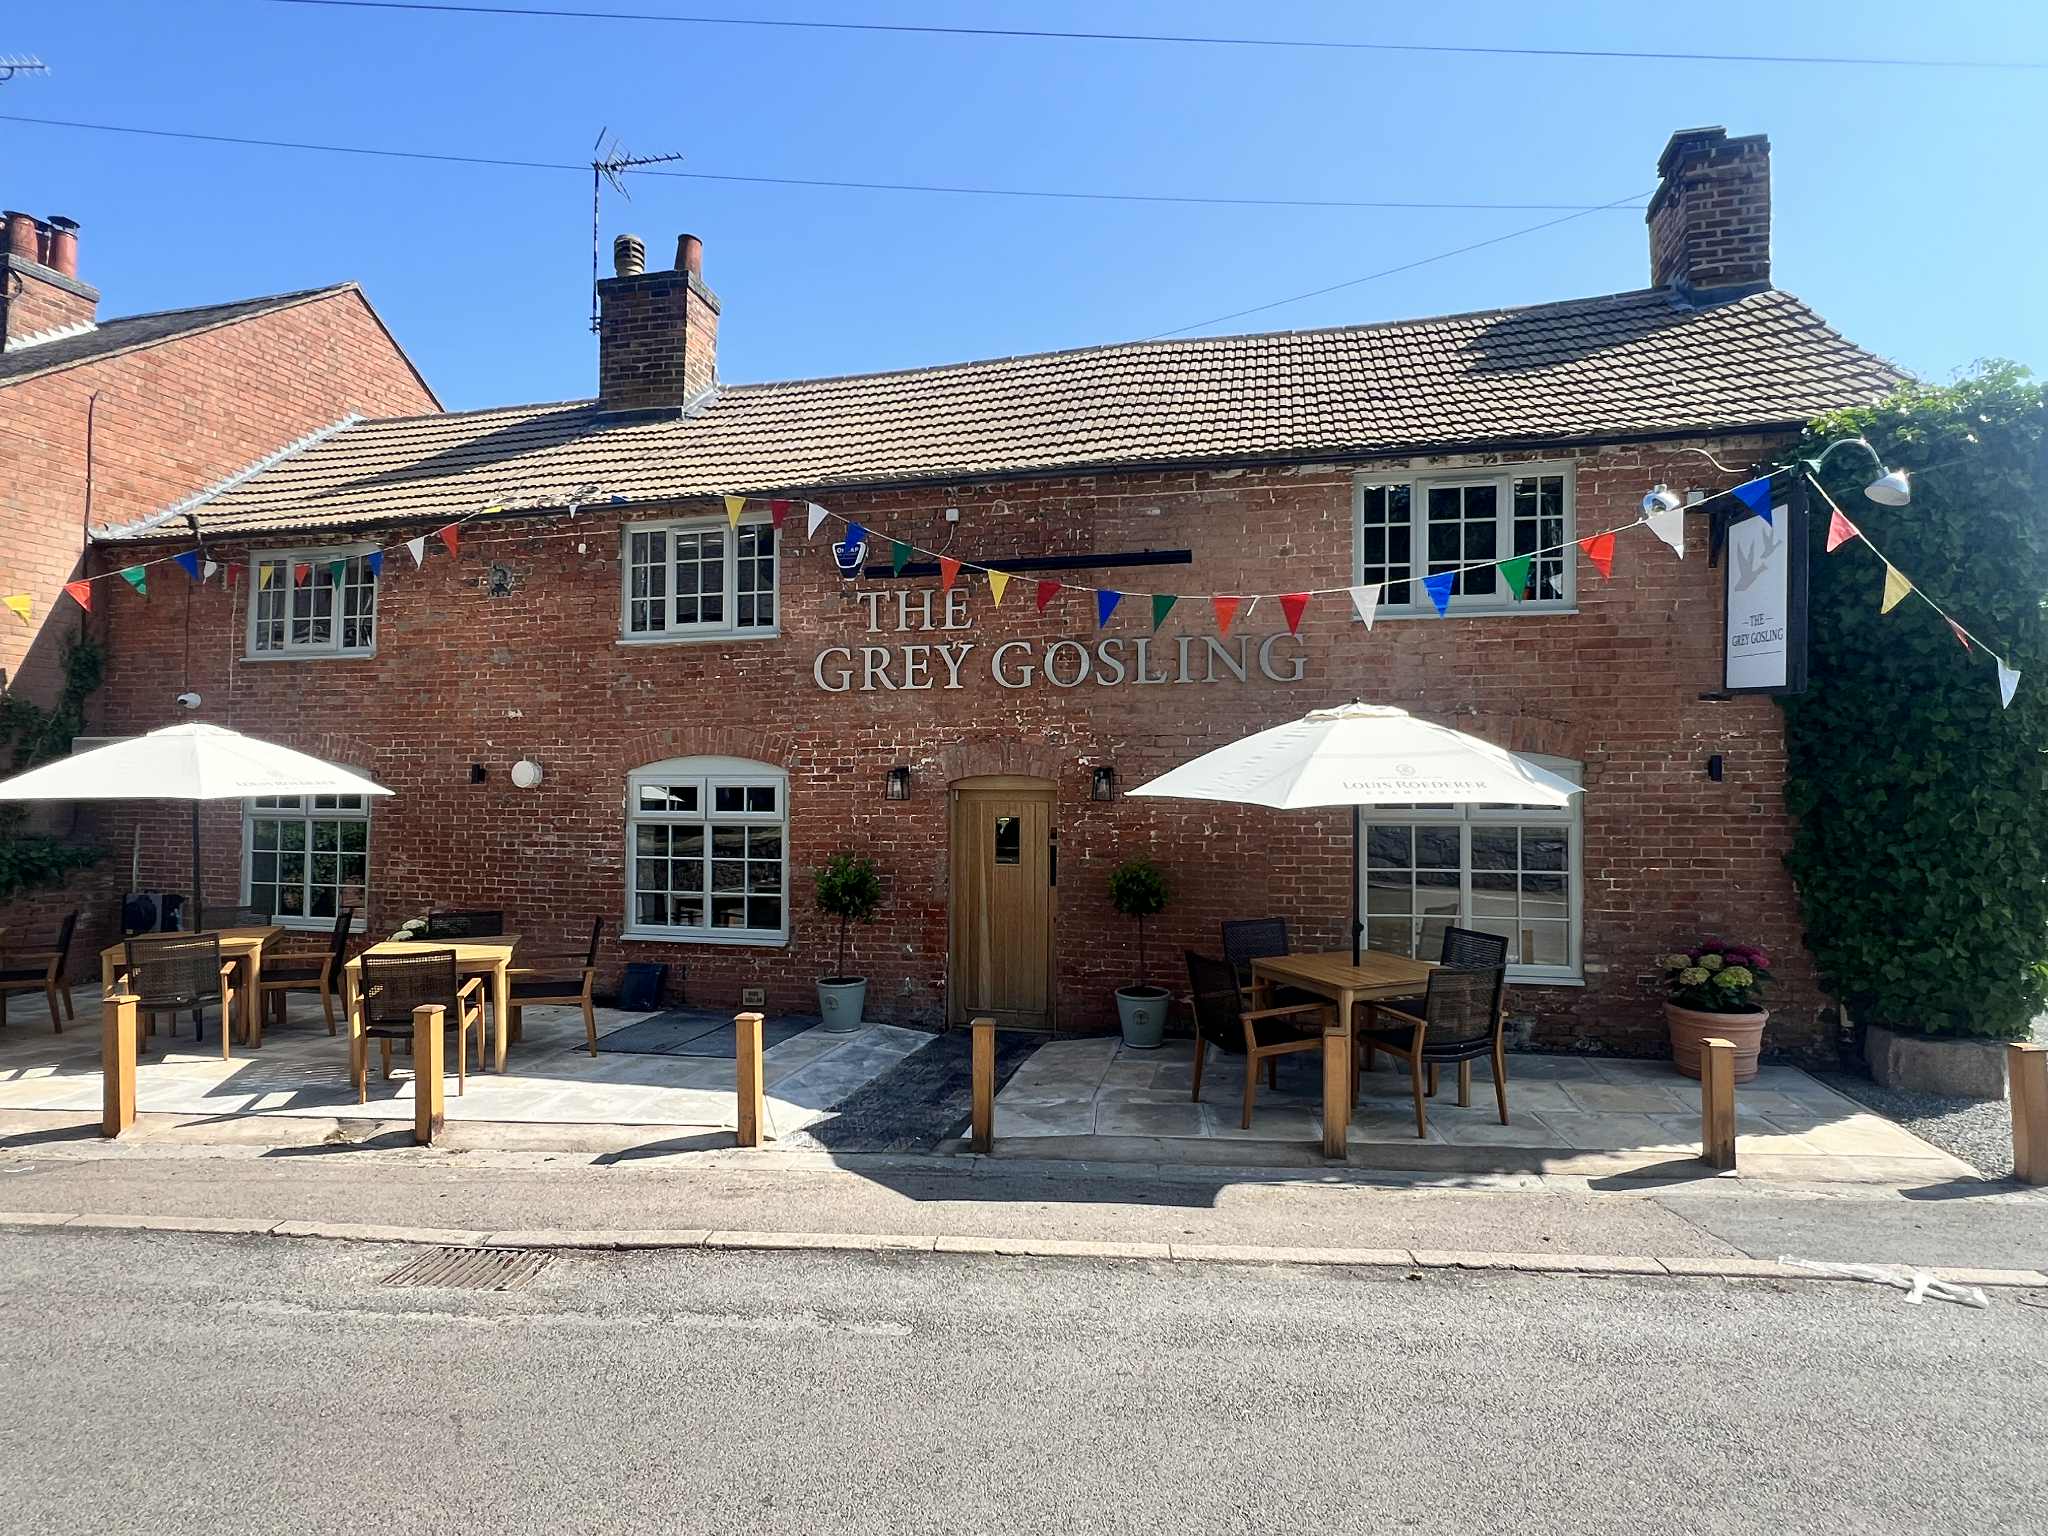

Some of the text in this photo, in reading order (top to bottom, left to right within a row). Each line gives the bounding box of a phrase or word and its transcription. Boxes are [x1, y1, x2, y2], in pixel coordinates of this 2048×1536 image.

[857, 587, 974, 634] THE
[1749, 613, 1764, 626] THE
[1732, 628, 1783, 646] GREY GOSLING
[813, 633, 1309, 692] GREY GOSLING
